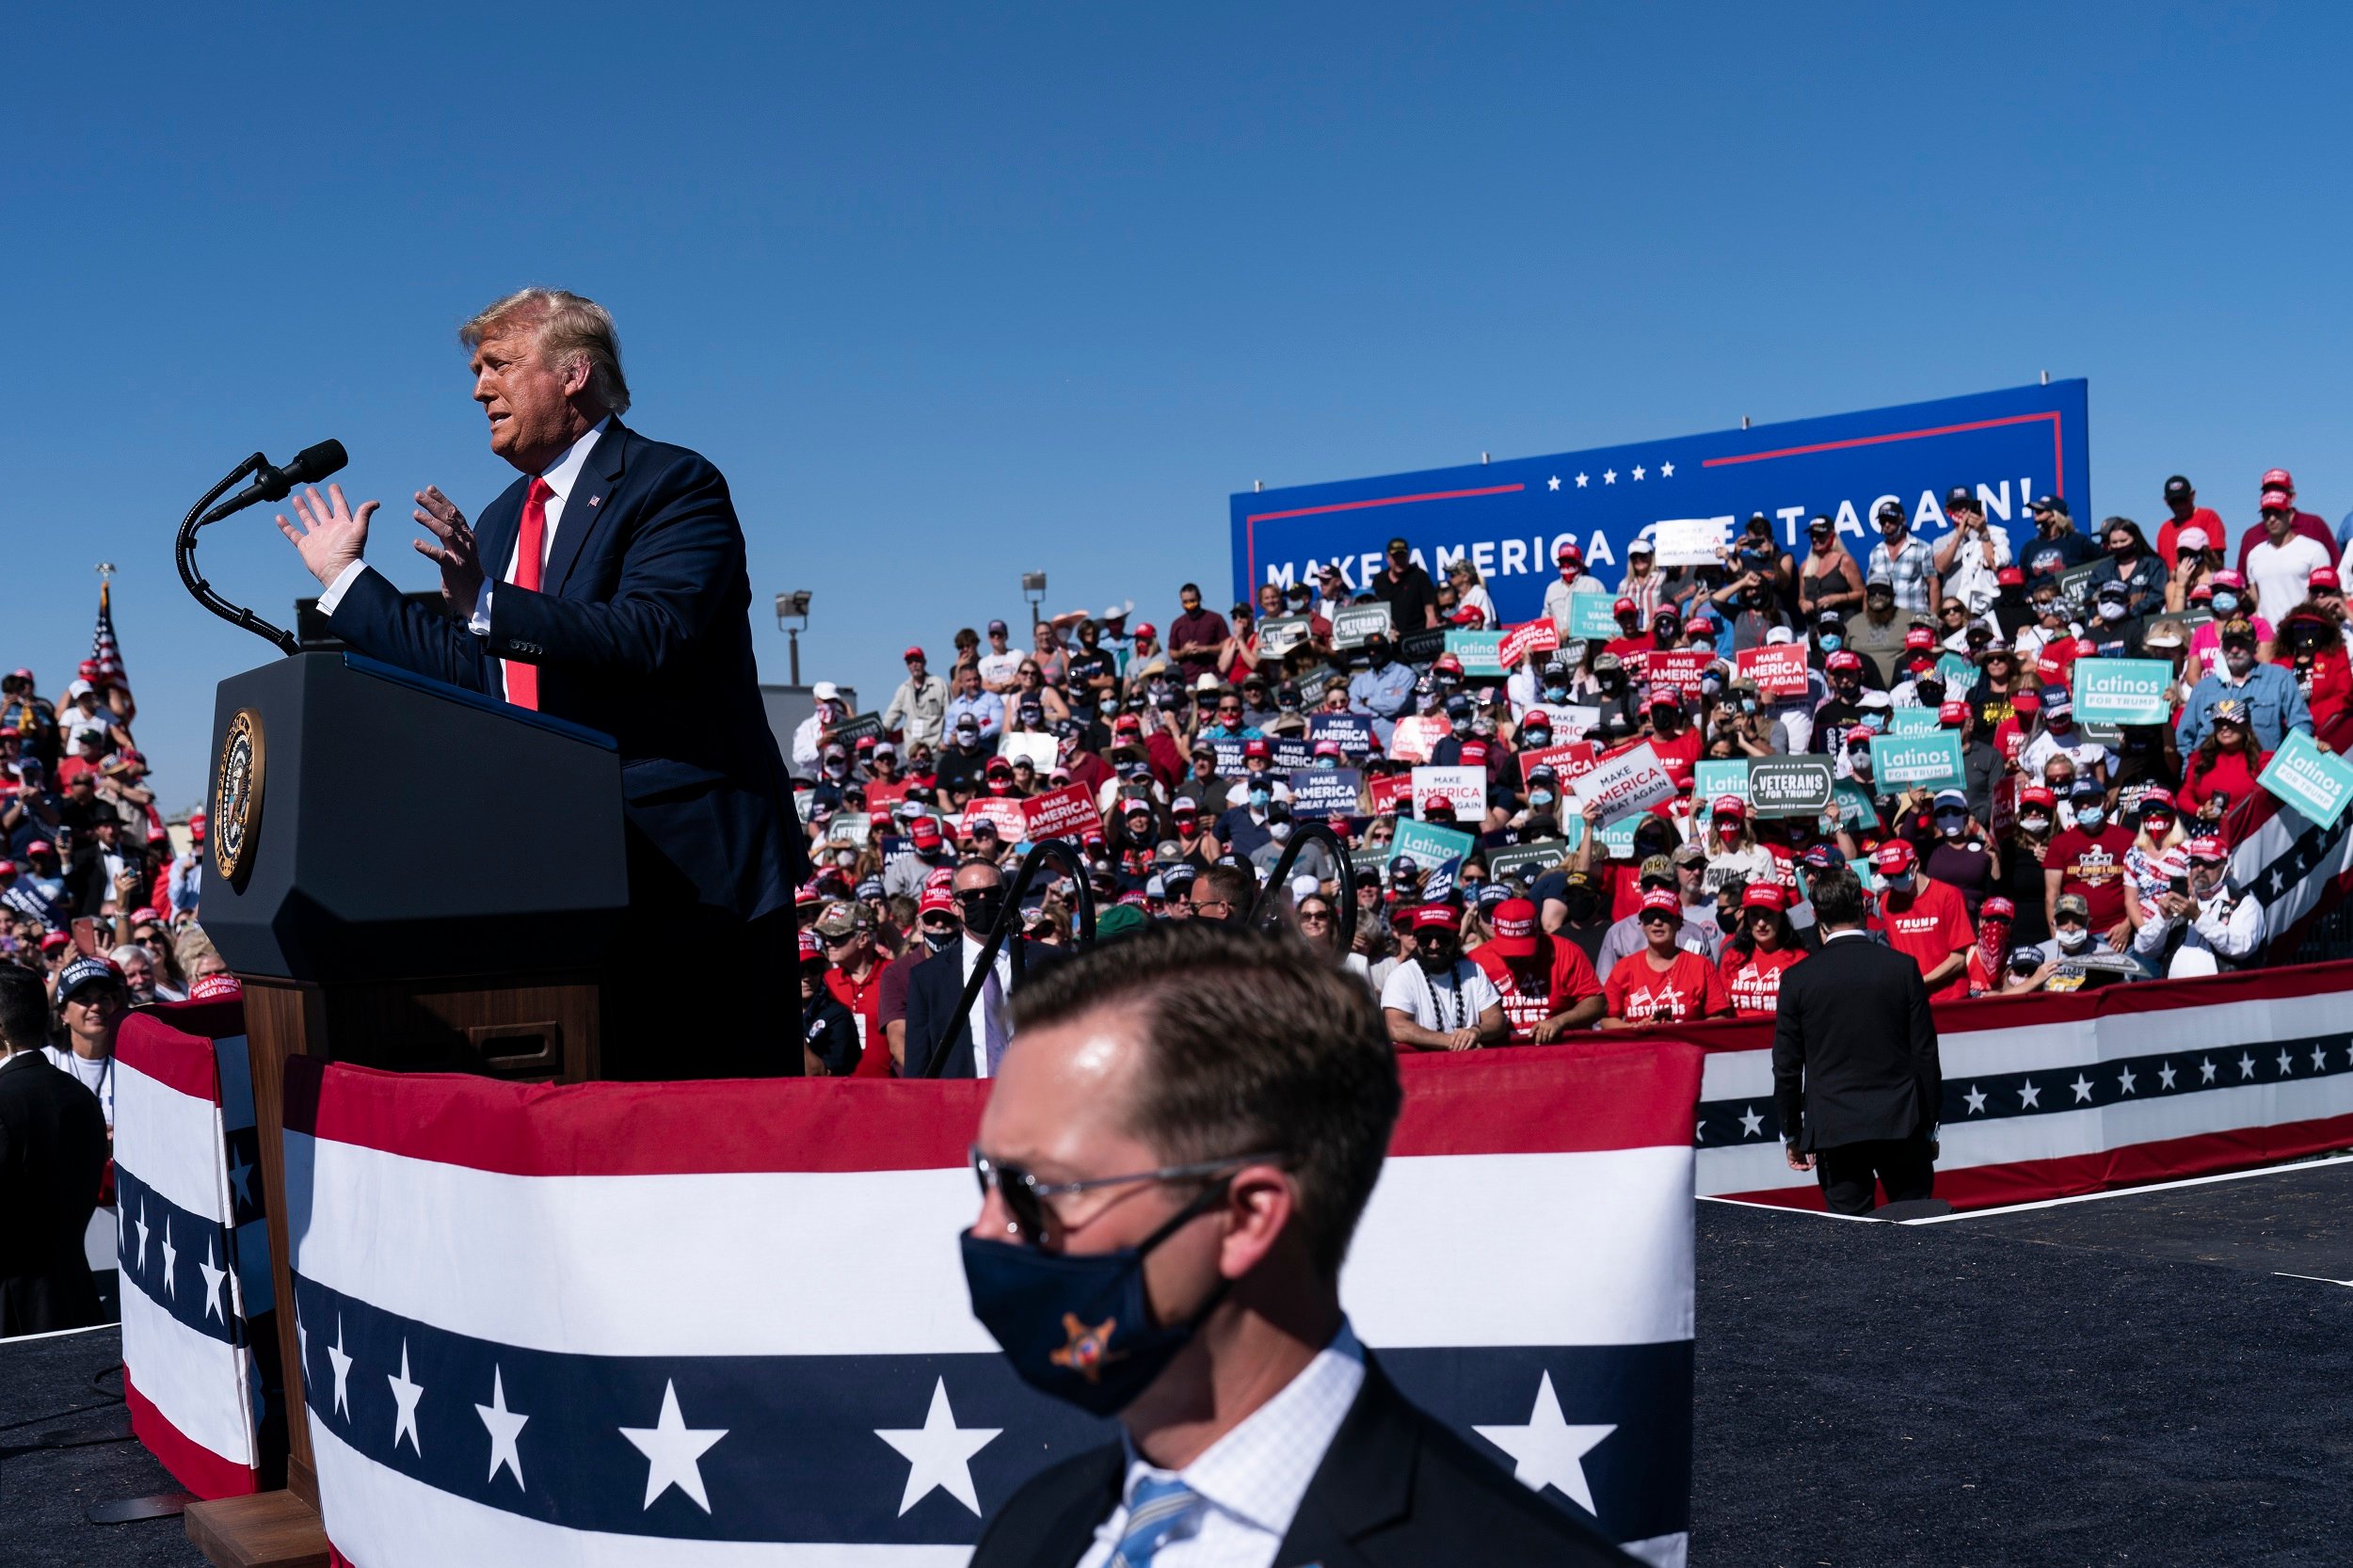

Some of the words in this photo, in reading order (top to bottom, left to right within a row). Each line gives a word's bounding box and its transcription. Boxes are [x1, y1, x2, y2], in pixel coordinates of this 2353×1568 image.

[1834, 477, 2033, 538] AGAN!
[1340, 616, 1385, 632] VETERANS
[1454, 640, 1495, 654] Latino
[1502, 627, 1555, 655] AMERICA
[1667, 658, 1695, 667] MAKE
[1756, 652, 1785, 664] MAKE
[1651, 668, 1703, 680] AMERIC
[1741, 661, 1803, 678] AMERICA
[1945, 664, 1978, 688] Latin
[1683, 681, 1702, 691] AGA
[1771, 675, 1804, 686] AGAIN
[2087, 673, 2159, 694] Latinos
[2089, 696, 2113, 707] FOR
[2118, 696, 2156, 707] TRUMP
[1329, 720, 1354, 729] MAKE
[1312, 728, 1369, 741] AMERICA
[1279, 744, 1305, 755] MAKE
[1340, 743, 1369, 751] AGAIN
[1273, 755, 1319, 768] MERICA
[1543, 752, 1573, 764] MAKE
[1882, 749, 1950, 767] Latinos
[1558, 759, 1593, 776] RICA
[1888, 770, 1910, 779] FOR
[1913, 766, 1949, 777] TRUMP
[2284, 746, 2344, 797] Latinos
[1310, 776, 1337, 786] MAKE
[1600, 765, 1632, 787] MAKE
[1706, 775, 1749, 792] Latin
[1759, 774, 1823, 791] VETERANS
[1294, 785, 1356, 800] AMERICA
[1417, 787, 1481, 798] AMERICA
[1590, 767, 1661, 807] AMERICA
[1633, 779, 1668, 803] AGAIN
[1766, 791, 1782, 799] FOR
[1784, 789, 1817, 799] TRUMP
[2279, 767, 2303, 789] FOR
[2302, 780, 2331, 808] TRUMP
[983, 804, 1009, 812] MAKE
[1042, 794, 1070, 809] MAKE
[1293, 800, 1323, 810] GREAT
[1325, 798, 1356, 808] AGAIN
[964, 811, 1023, 825] AMERICA
[1030, 798, 1093, 828] AMERICA
[1034, 822, 1064, 837] GREAT
[1065, 811, 1096, 826] AGAIN
[837, 826, 871, 839] VETERA
[1403, 831, 1461, 859] Latinos
[1643, 860, 1667, 872] ARMY
[25, 890, 49, 913] MAKE
[1895, 917, 1939, 929] TRUMP
[62, 961, 82, 978] MAKE
[68, 969, 89, 984] GREAT
[192, 980, 211, 995] MAKE
[211, 976, 240, 988] AMERICA
[198, 986, 217, 1000] GREAT
[217, 984, 238, 995] AGAIN
[1731, 979, 1780, 992] ASSYRIAN
[1731, 995, 1778, 1010] TRUM
